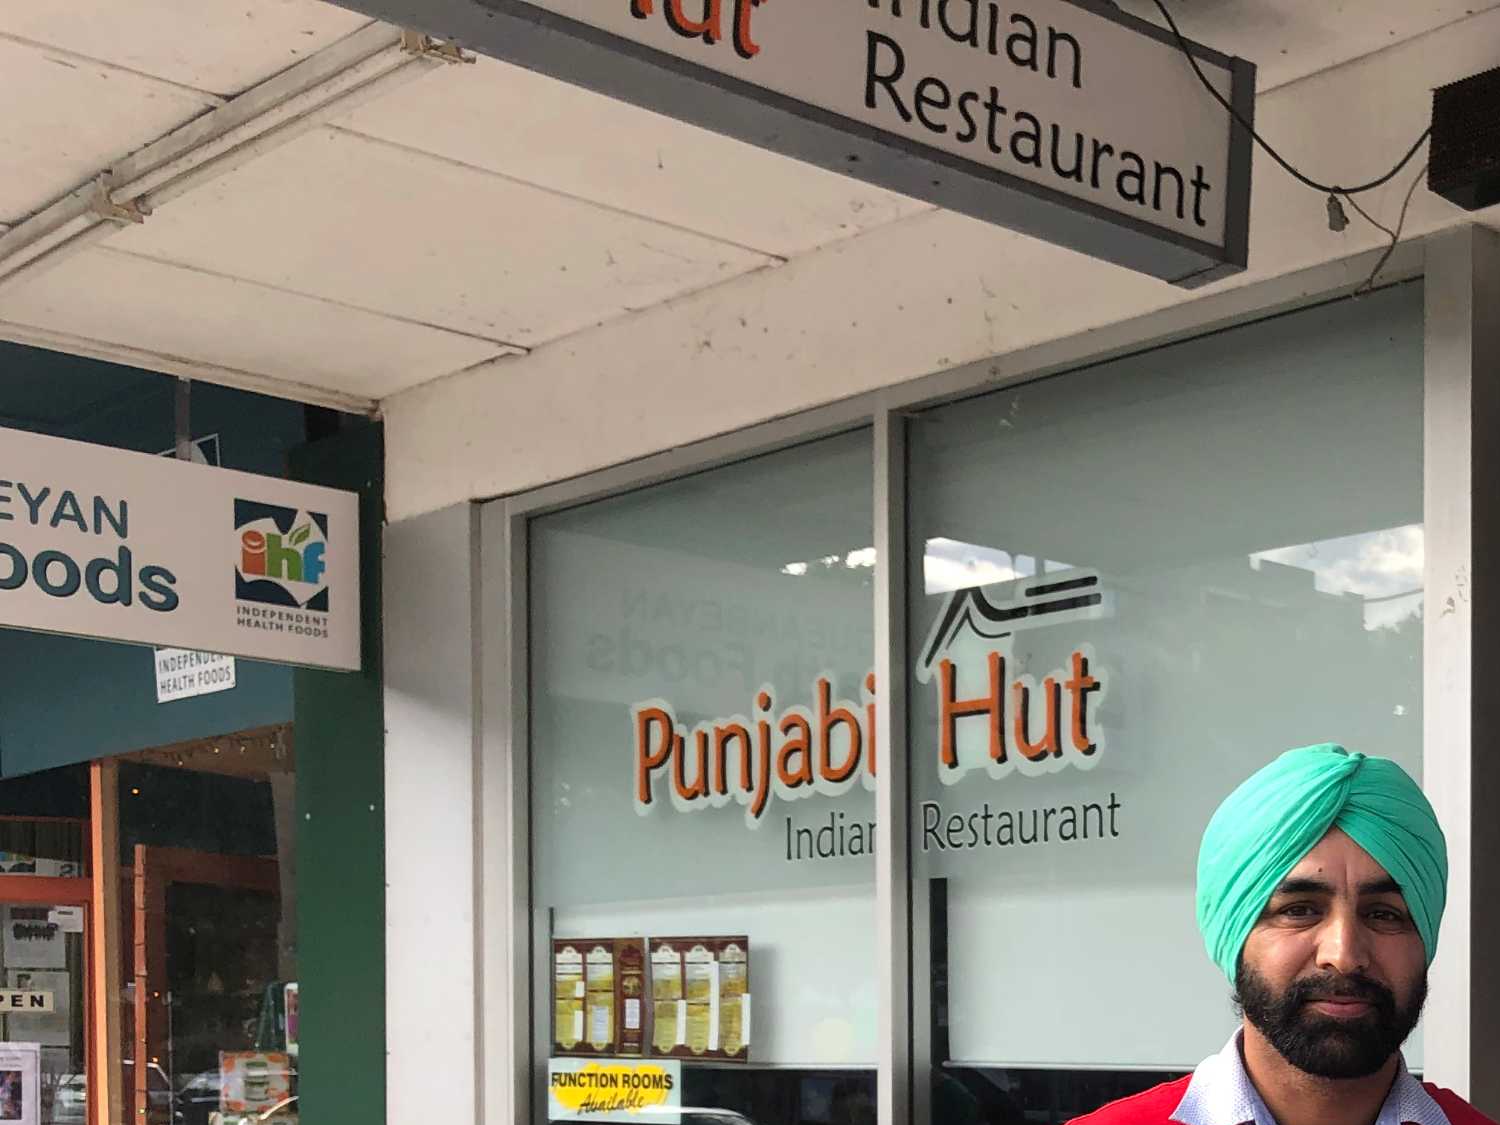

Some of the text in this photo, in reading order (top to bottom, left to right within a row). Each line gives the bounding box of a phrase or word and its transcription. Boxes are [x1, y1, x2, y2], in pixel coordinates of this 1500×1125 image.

[630, 0, 760, 58] ut
[869, 0, 1083, 88] ndian
[864, 30, 1211, 226] Restaurant
[236, 606, 328, 626] INDEPENDENT
[237, 618, 328, 638] HEALTH FOODS
[159, 652, 229, 673] INDEPENDEN
[160, 666, 231, 695] HEALTH FOODS
[635, 651, 1102, 818] Punjabi Hut
[923, 793, 1122, 851] Restaurant
[551, 1072, 674, 1090] FUNCTION ROOMS
[577, 1091, 644, 1115] Available
